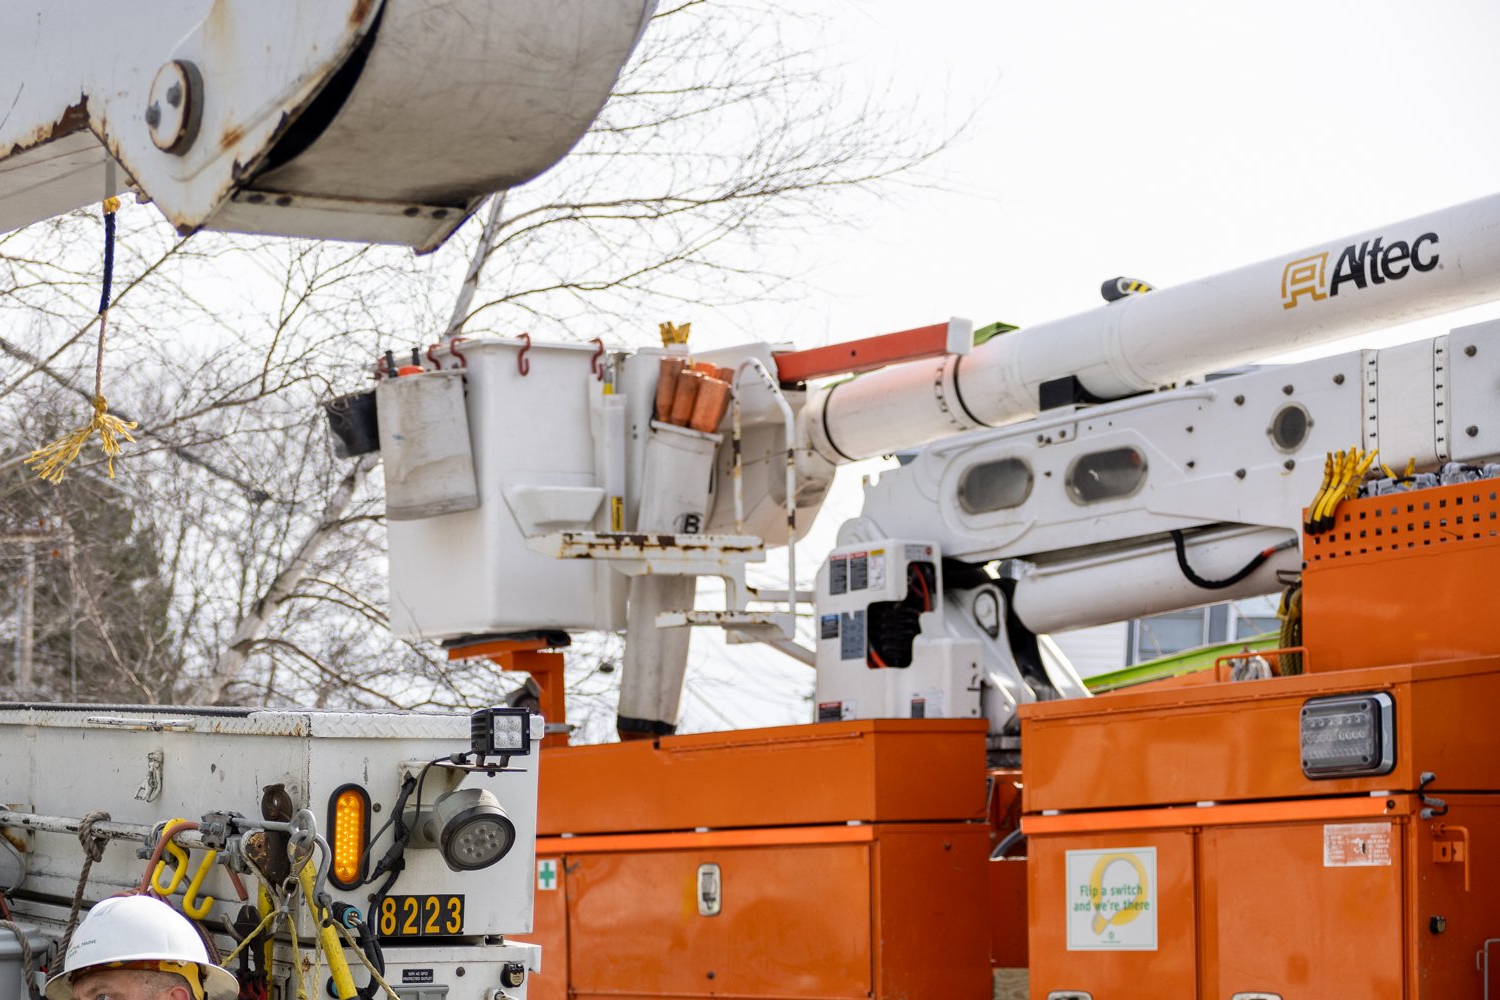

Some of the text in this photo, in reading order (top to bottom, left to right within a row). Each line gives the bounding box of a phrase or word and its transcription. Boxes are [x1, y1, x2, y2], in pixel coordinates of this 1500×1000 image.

[1329, 232, 1439, 297] Altec
[1080, 884, 1143, 898] Flip a switch
[380, 895, 462, 936] 8223
[1074, 899, 1150, 912] and we're there
